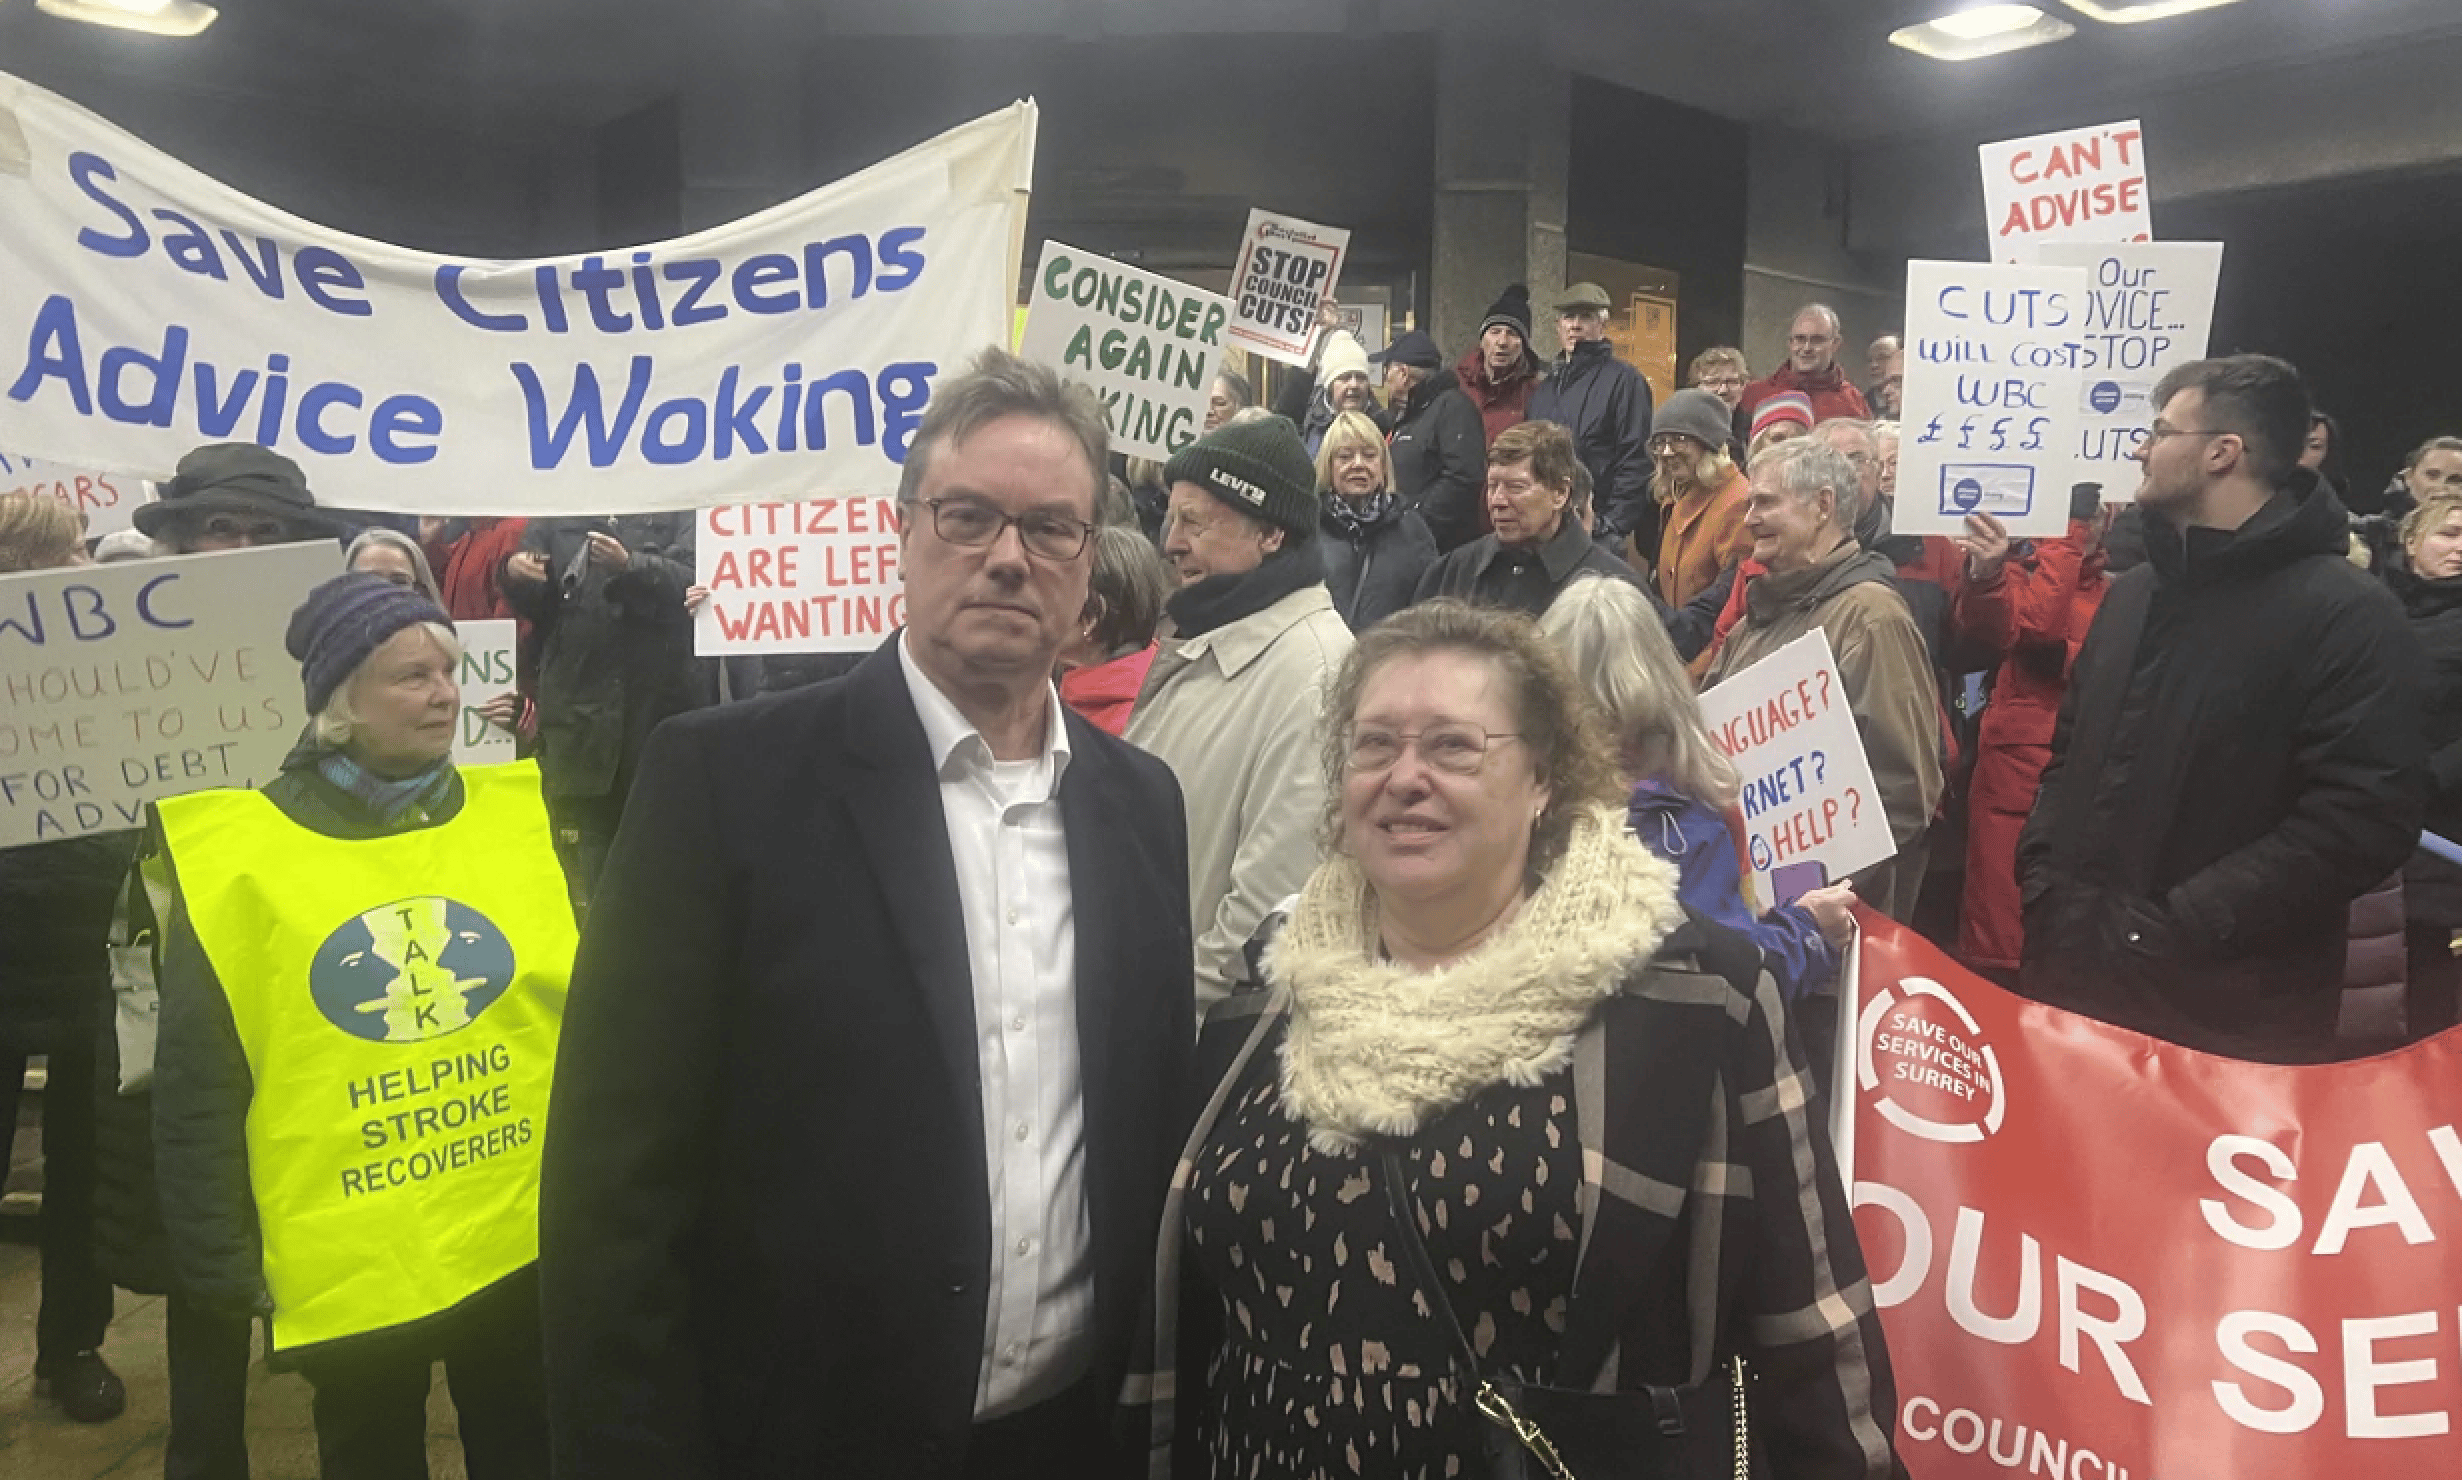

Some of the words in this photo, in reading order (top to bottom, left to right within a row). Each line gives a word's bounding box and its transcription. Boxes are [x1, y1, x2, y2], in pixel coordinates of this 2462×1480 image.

[2010, 130, 2140, 184] CAN'T
[2000, 177, 2144, 236] ADVISE
[68, 151, 372, 316] Save
[435, 226, 926, 333] Citizens
[1252, 246, 1326, 288] STOP
[1044, 256, 1226, 346] CONSIDER
[1240, 294, 1315, 336] CUTS!
[1245, 275, 1318, 309] COUNCIL
[1939, 285, 2068, 328] CUTS
[8, 295, 442, 464] Advice
[510, 355, 937, 469] Woking
[1064, 324, 1205, 390] AGAIN
[1100, 386, 1196, 454] KING
[1958, 374, 2048, 408] WBC
[2074, 428, 2151, 461] UTS
[710, 546, 798, 590] ARE
[713, 594, 907, 641] WANTING
[7, 647, 256, 705] HOULD'VE
[0, 714, 98, 757] OME
[122, 706, 183, 742] TO
[1710, 669, 1830, 757] NGUAGE?
[2, 764, 91, 806] FOR
[120, 741, 239, 788] DEBT
[1743, 750, 1826, 820] RNET?
[37, 798, 141, 840] ADV
[396, 908, 440, 1029] TALK
[1877, 1033, 1973, 1079] SERVICES
[1974, 1071, 1991, 1095] IN
[1891, 1013, 1946, 1044] SAVE
[1950, 1035, 1983, 1068] OUR
[348, 1043, 511, 1109] HELPING
[1893, 1061, 1976, 1102] SURREY
[362, 1083, 511, 1149] STROKE
[341, 1117, 532, 1198] RECOVERERS
[2210, 1306, 2462, 1438] SE
